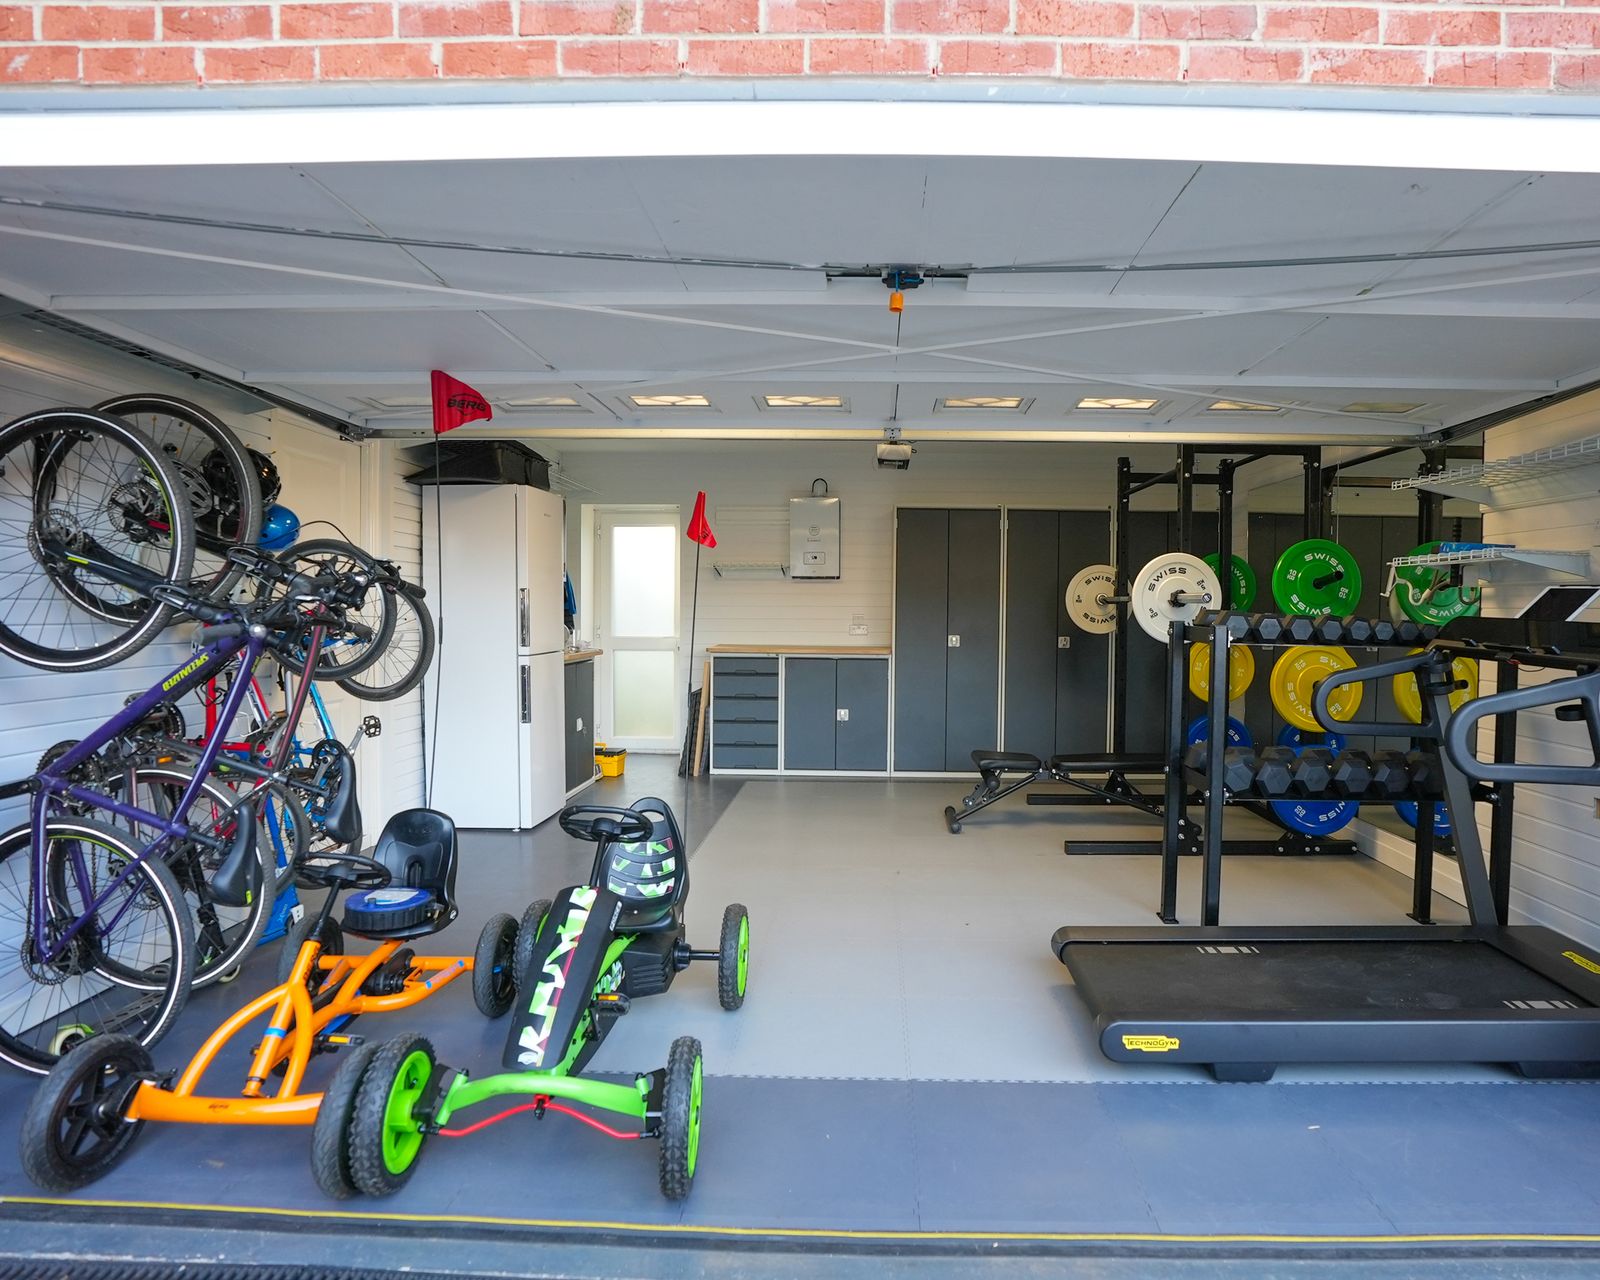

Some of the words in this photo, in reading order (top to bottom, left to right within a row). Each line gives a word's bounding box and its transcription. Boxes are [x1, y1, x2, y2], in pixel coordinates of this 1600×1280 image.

[447, 399, 486, 412] BERG
[1304, 552, 1344, 573] SWISS
[1147, 567, 1187, 592] SWISS
[1231, 566, 1246, 594] WISS
[1291, 594, 1331, 616] SWISS
[1083, 612, 1116, 624] SWISS
[162, 651, 209, 692] SPECIALIZED
